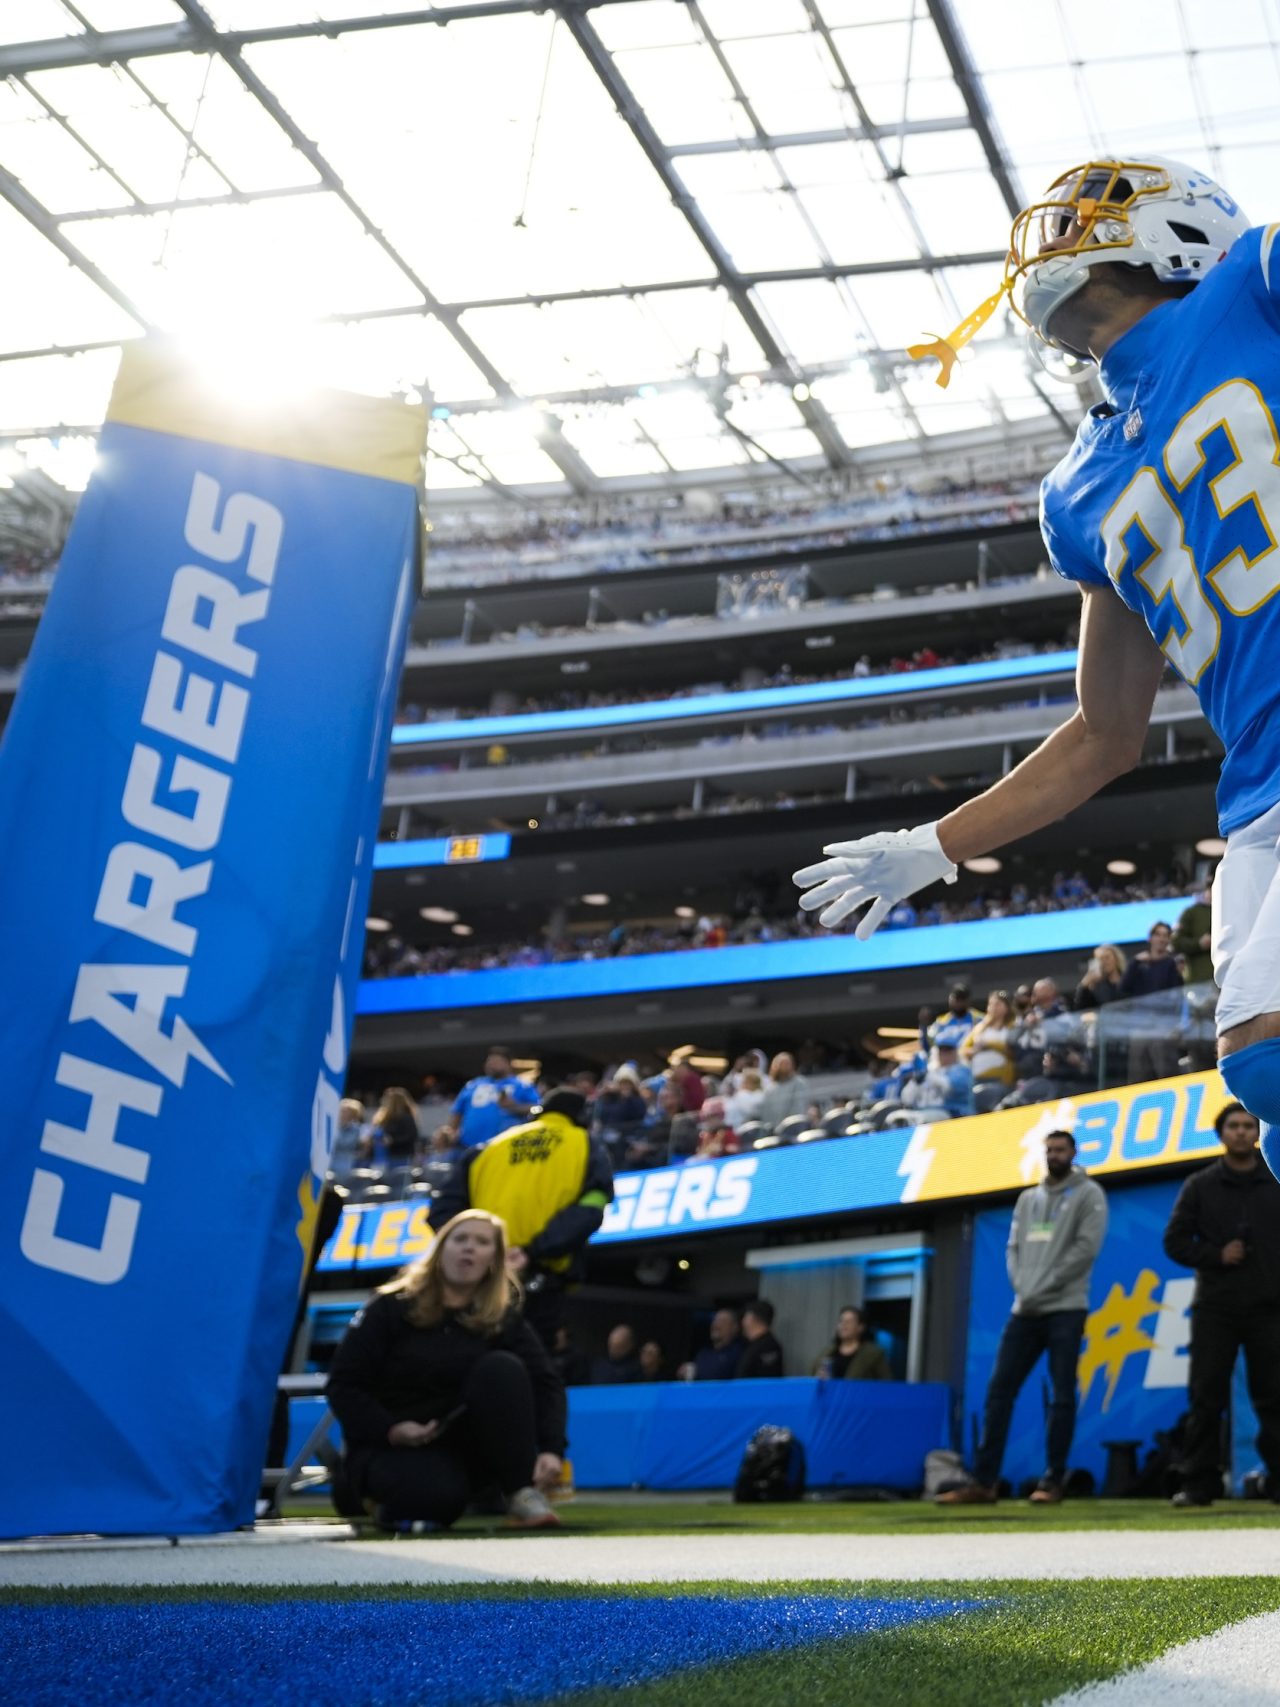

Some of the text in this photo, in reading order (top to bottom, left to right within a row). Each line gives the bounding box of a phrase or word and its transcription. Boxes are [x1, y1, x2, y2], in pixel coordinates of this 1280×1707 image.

[19, 471, 286, 1286] CHARGERS
[1020, 1082, 1233, 1185] #BOL
[320, 1205, 436, 1261] LES
